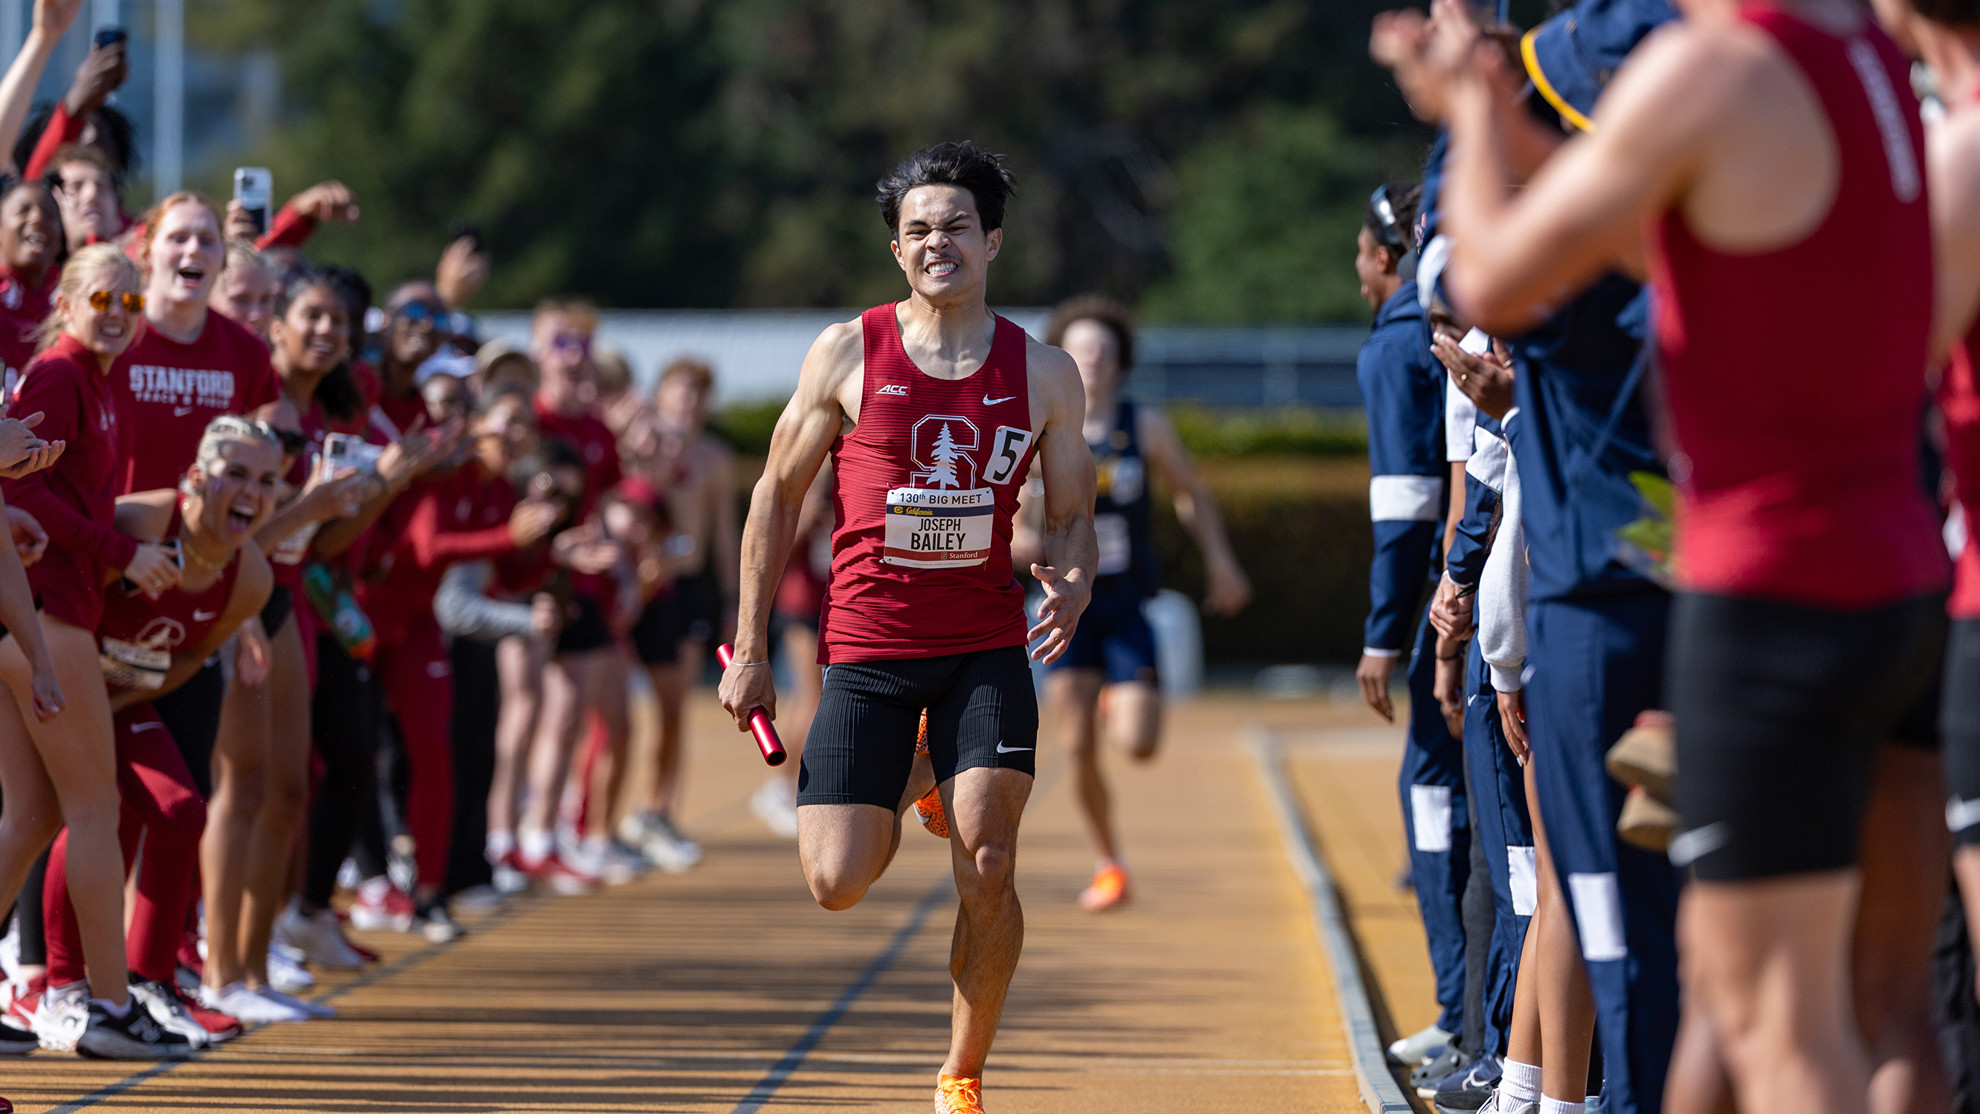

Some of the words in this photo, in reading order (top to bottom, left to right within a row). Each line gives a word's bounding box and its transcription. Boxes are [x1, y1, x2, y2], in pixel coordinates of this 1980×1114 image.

[129, 364, 235, 399] STANFORD
[878, 384, 908, 395] ACC
[992, 430, 1026, 482] 5
[900, 493, 926, 504] 130th
[929, 494, 948, 505] BIG
[951, 493, 982, 505] MEET
[905, 506, 934, 517] California
[918, 518, 961, 532] JOSEPH
[910, 532, 967, 551] BAILEY
[949, 551, 978, 559] Stanford
